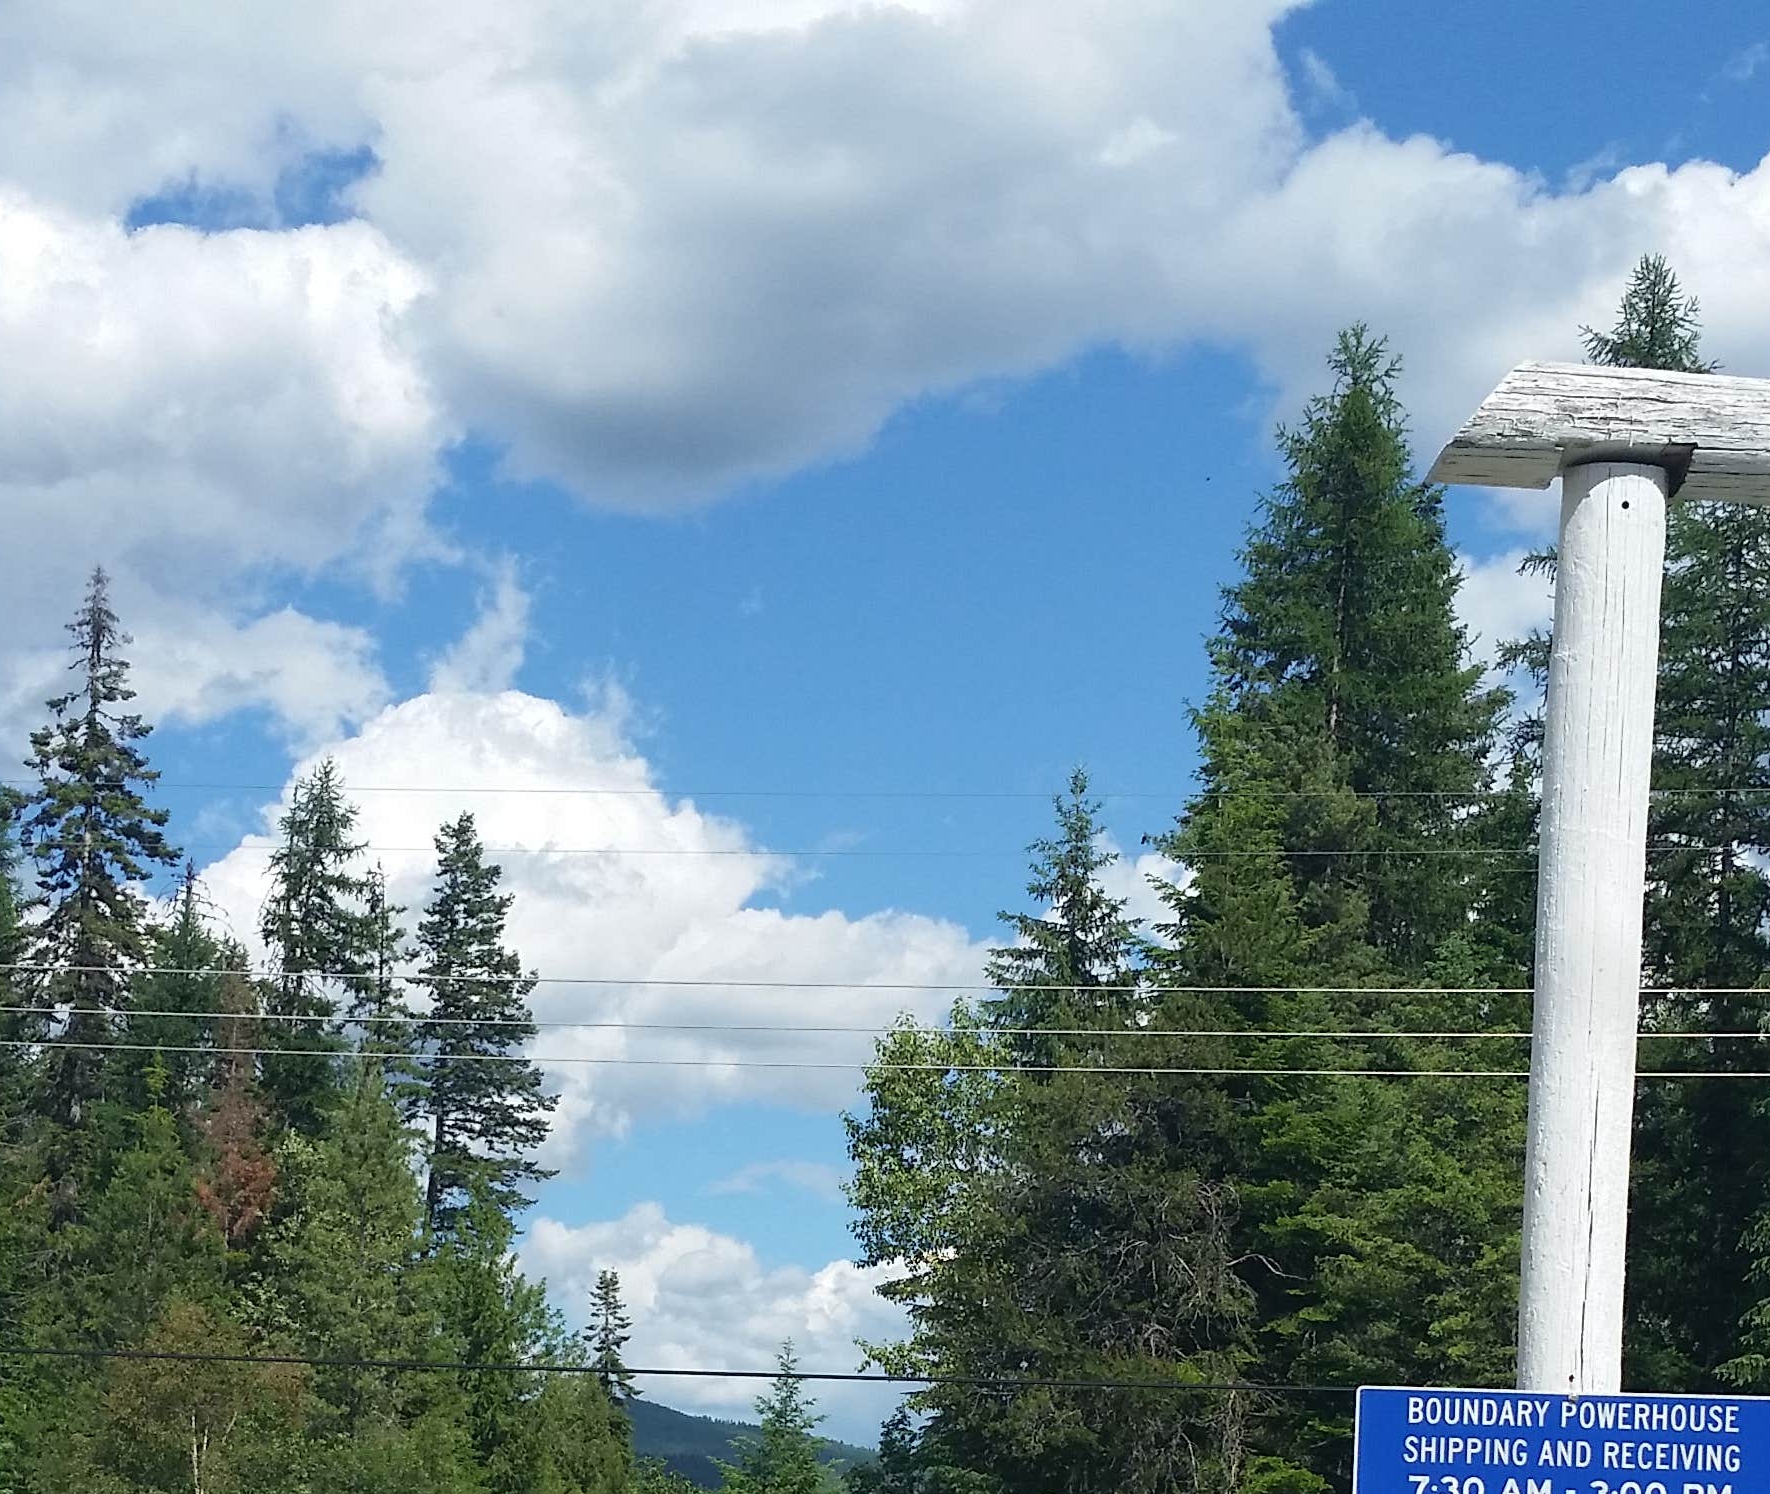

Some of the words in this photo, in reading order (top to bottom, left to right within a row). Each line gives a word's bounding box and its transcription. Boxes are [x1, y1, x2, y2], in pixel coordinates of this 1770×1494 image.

[1408, 1397, 1550, 1428] BOUNDARY
[1561, 1401, 1740, 1433] POWERHOUSE
[1403, 1437, 1528, 1466] SHIPPING
[1539, 1440, 1591, 1468] AND
[1604, 1442, 1740, 1472] RECEIVING
